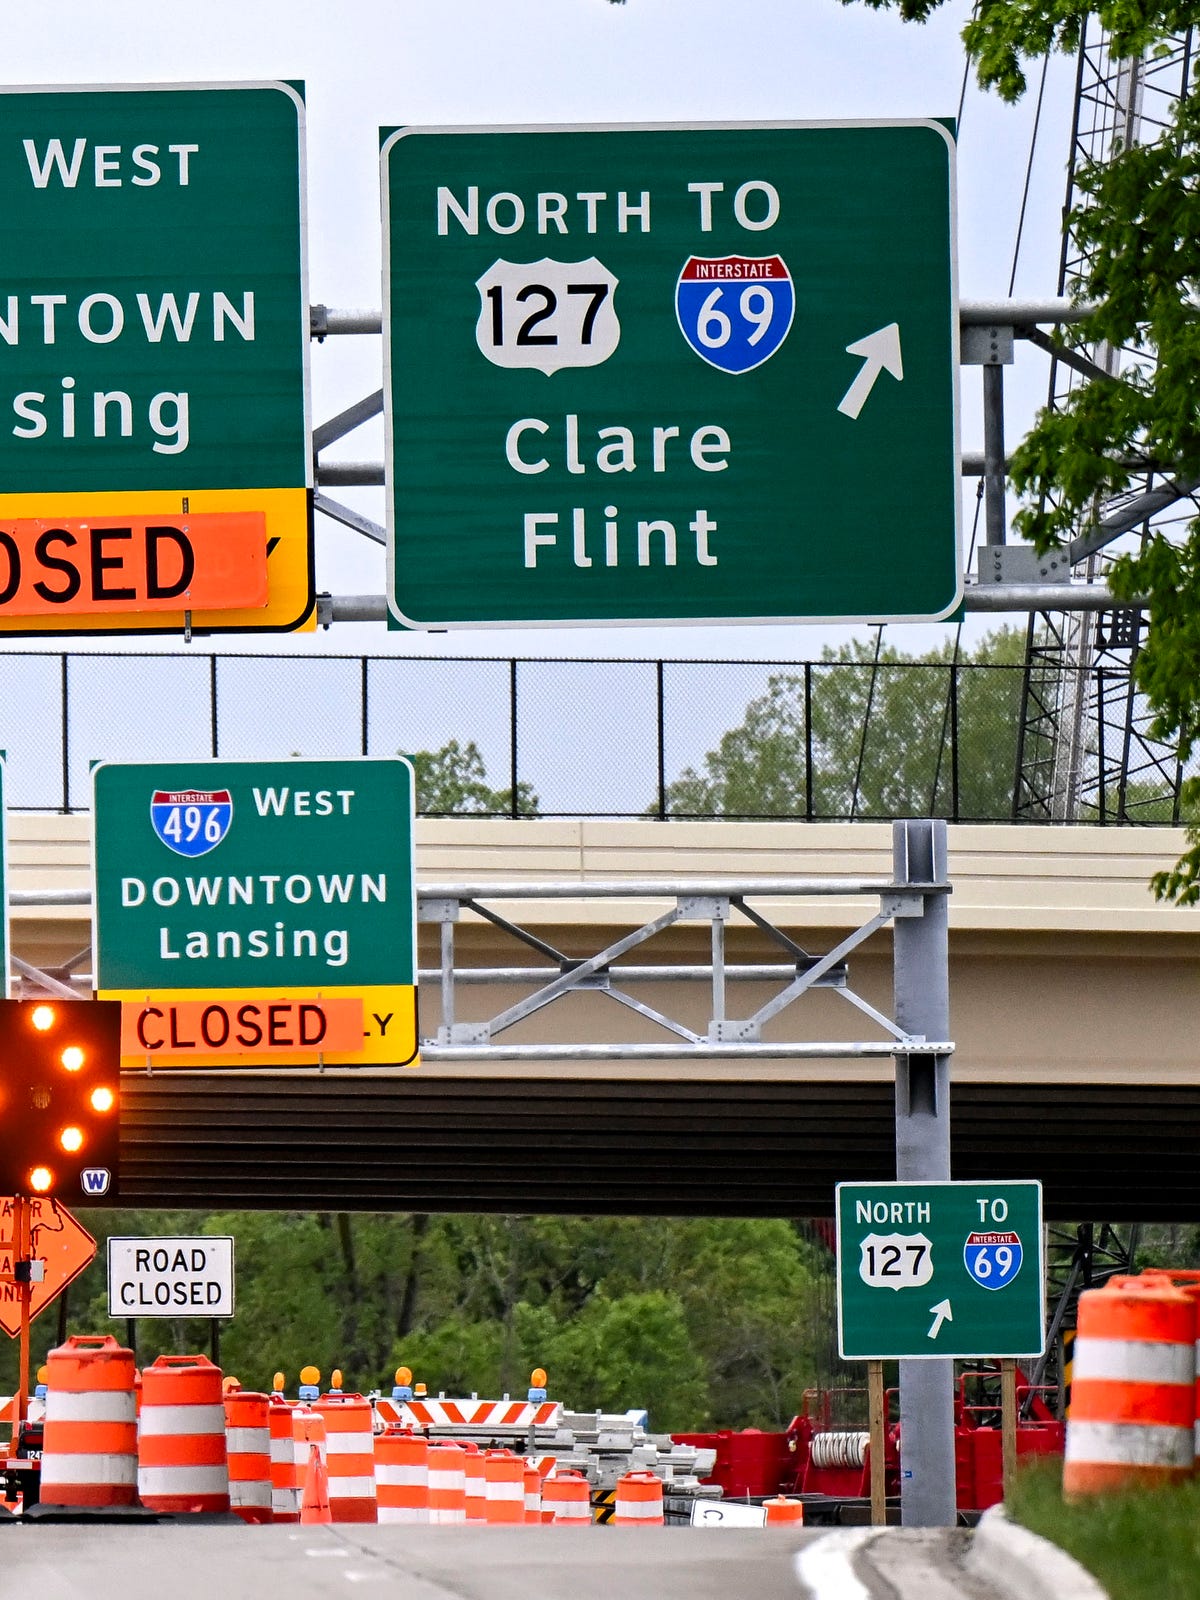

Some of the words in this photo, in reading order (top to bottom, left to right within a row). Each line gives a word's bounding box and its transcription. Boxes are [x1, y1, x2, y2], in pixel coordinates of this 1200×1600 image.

[22, 138, 199, 189] WEST
[437, 186, 650, 235] NORTH
[688, 180, 780, 232] TO
[695, 262, 773, 279] INTERSTATE
[486, 283, 609, 347] 127
[696, 286, 774, 349] 69
[505, 414, 731, 474] Clare
[524, 505, 718, 568] Flint
[169, 793, 214, 803] INTERSTATE
[252, 787, 355, 816] WEST
[163, 806, 221, 843] 496
[121, 873, 386, 907] DOWNTOWN
[160, 922, 349, 967] Lansing
[137, 1004, 327, 1050] CLOSED
[86, 1173, 105, 1190] W
[856, 1200, 931, 1224] NORTH
[977, 1198, 1009, 1223] TO
[972, 1235, 1013, 1243] INTERSTATE
[136, 1249, 206, 1272] ROAD
[866, 1245, 926, 1276] 127
[974, 1246, 1013, 1279] 69
[120, 1281, 222, 1306] CLOSED
